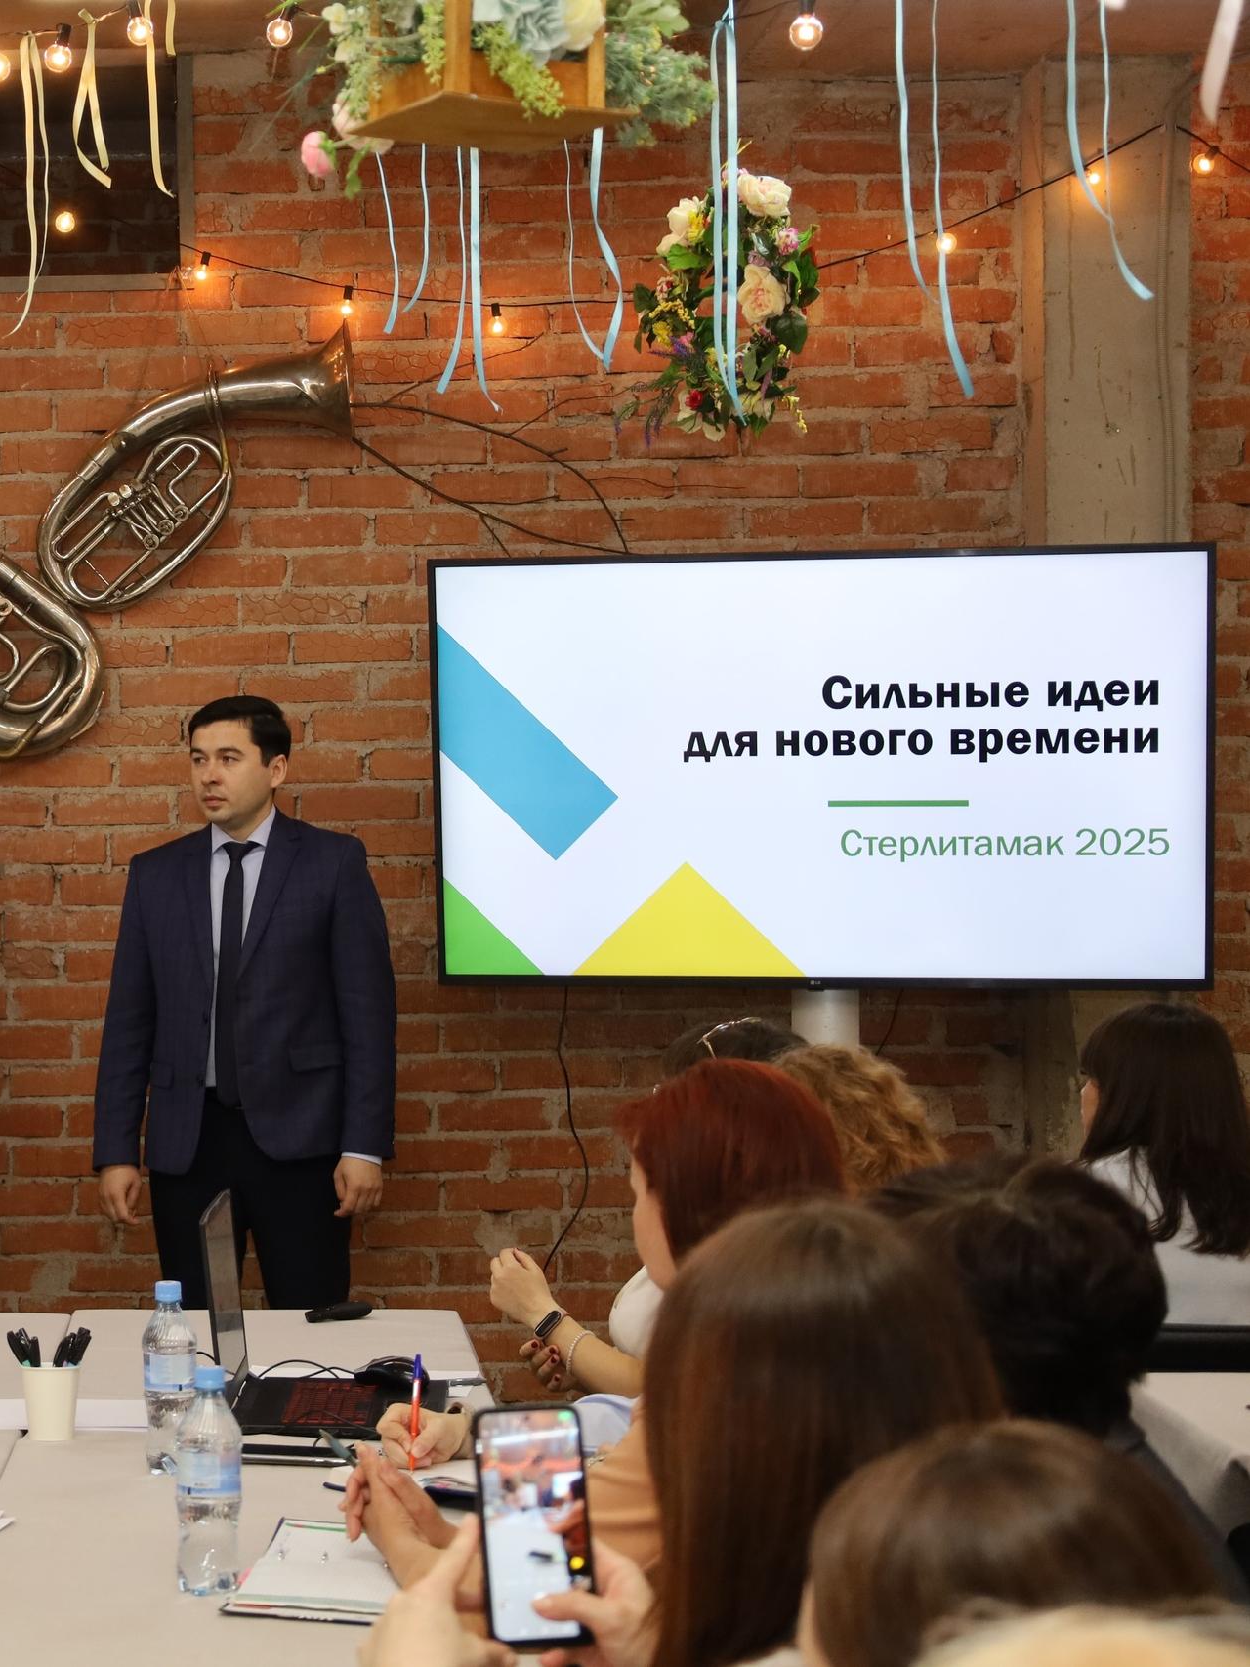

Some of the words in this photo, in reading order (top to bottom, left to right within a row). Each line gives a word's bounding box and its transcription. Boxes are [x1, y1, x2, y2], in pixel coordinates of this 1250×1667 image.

[822, 675, 1030, 710] Сильные
[1048, 679, 1160, 712] идеи
[684, 731, 759, 762] для
[775, 728, 934, 757] нового
[949, 727, 1160, 762] времени
[840, 829, 1064, 862] Стерлитамак
[1074, 828, 1171, 857] 2025
